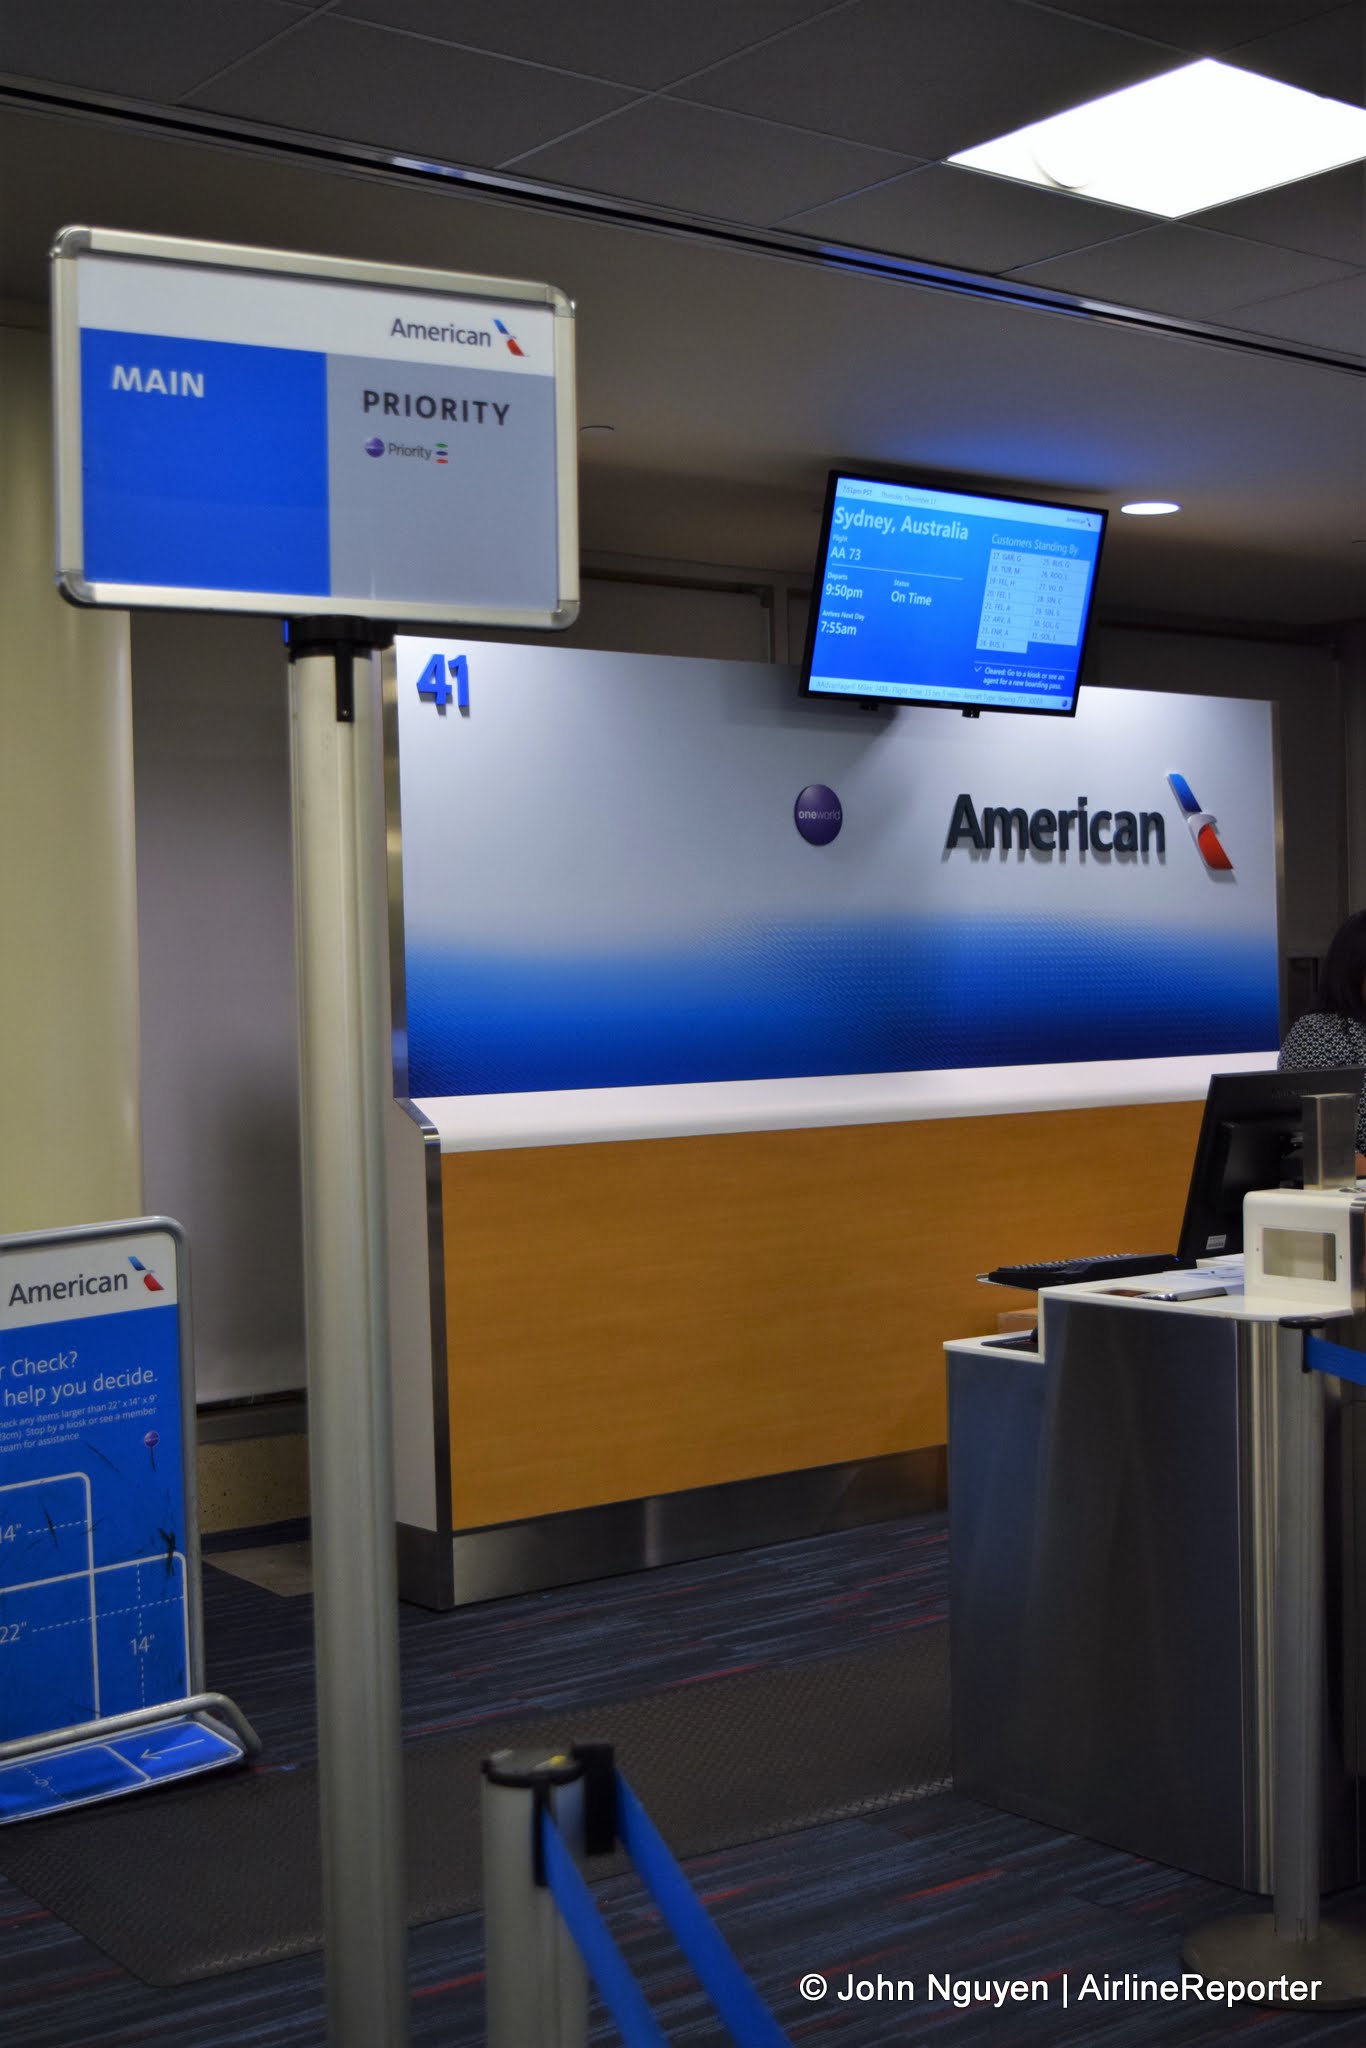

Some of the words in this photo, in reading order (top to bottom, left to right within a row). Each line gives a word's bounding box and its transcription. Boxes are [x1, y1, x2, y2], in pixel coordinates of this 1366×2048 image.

[390, 317, 492, 348] American
[111, 364, 205, 399] MAIN
[362, 390, 512, 427] PRIORITY
[388, 442, 432, 461] Priority
[834, 506, 896, 535] Sydney,
[900, 515, 969, 540] Australia
[832, 534, 848, 544] Flight
[991, 534, 1032, 549] Customers
[1034, 539, 1068, 555] Standing
[1069, 544, 1079, 557] By
[830, 546, 846, 559] AA
[849, 548, 861, 561] 73
[827, 571, 848, 581] Departs
[893, 579, 910, 588] Status
[825, 583, 863, 600] 9:50pm
[891, 590, 906, 603] On
[908, 592, 932, 606] Time
[841, 611, 854, 620] Next
[855, 613, 865, 621] Day
[820, 621, 857, 635] 7:55am
[416, 654, 470, 707] 41
[1007, 668, 1015, 676] Go
[982, 677, 999, 686] agent
[1025, 680, 1049, 691] boarding
[798, 809, 841, 820] oneworld
[946, 794, 1166, 853] American
[8, 1272, 128, 1307] American
[12, 1351, 78, 1377] Check?
[5, 1384, 46, 1407] help
[52, 1381, 87, 1405] you
[93, 1367, 158, 1392] decide.
[19, 1416, 35, 1427] any
[36, 1412, 60, 1422] items
[61, 1407, 86, 1419] larger
[87, 1403, 107, 1414] than
[25, 1425, 45, 1437] Stop
[47, 1422, 58, 1434] by
[66, 1418, 87, 1429] kiosk
[88, 1417, 98, 1425] or
[99, 1414, 113, 1423] see
[121, 1406, 157, 1419] member
[24, 1438, 37, 1449] for
[130, 1633, 155, 1656] 14"
